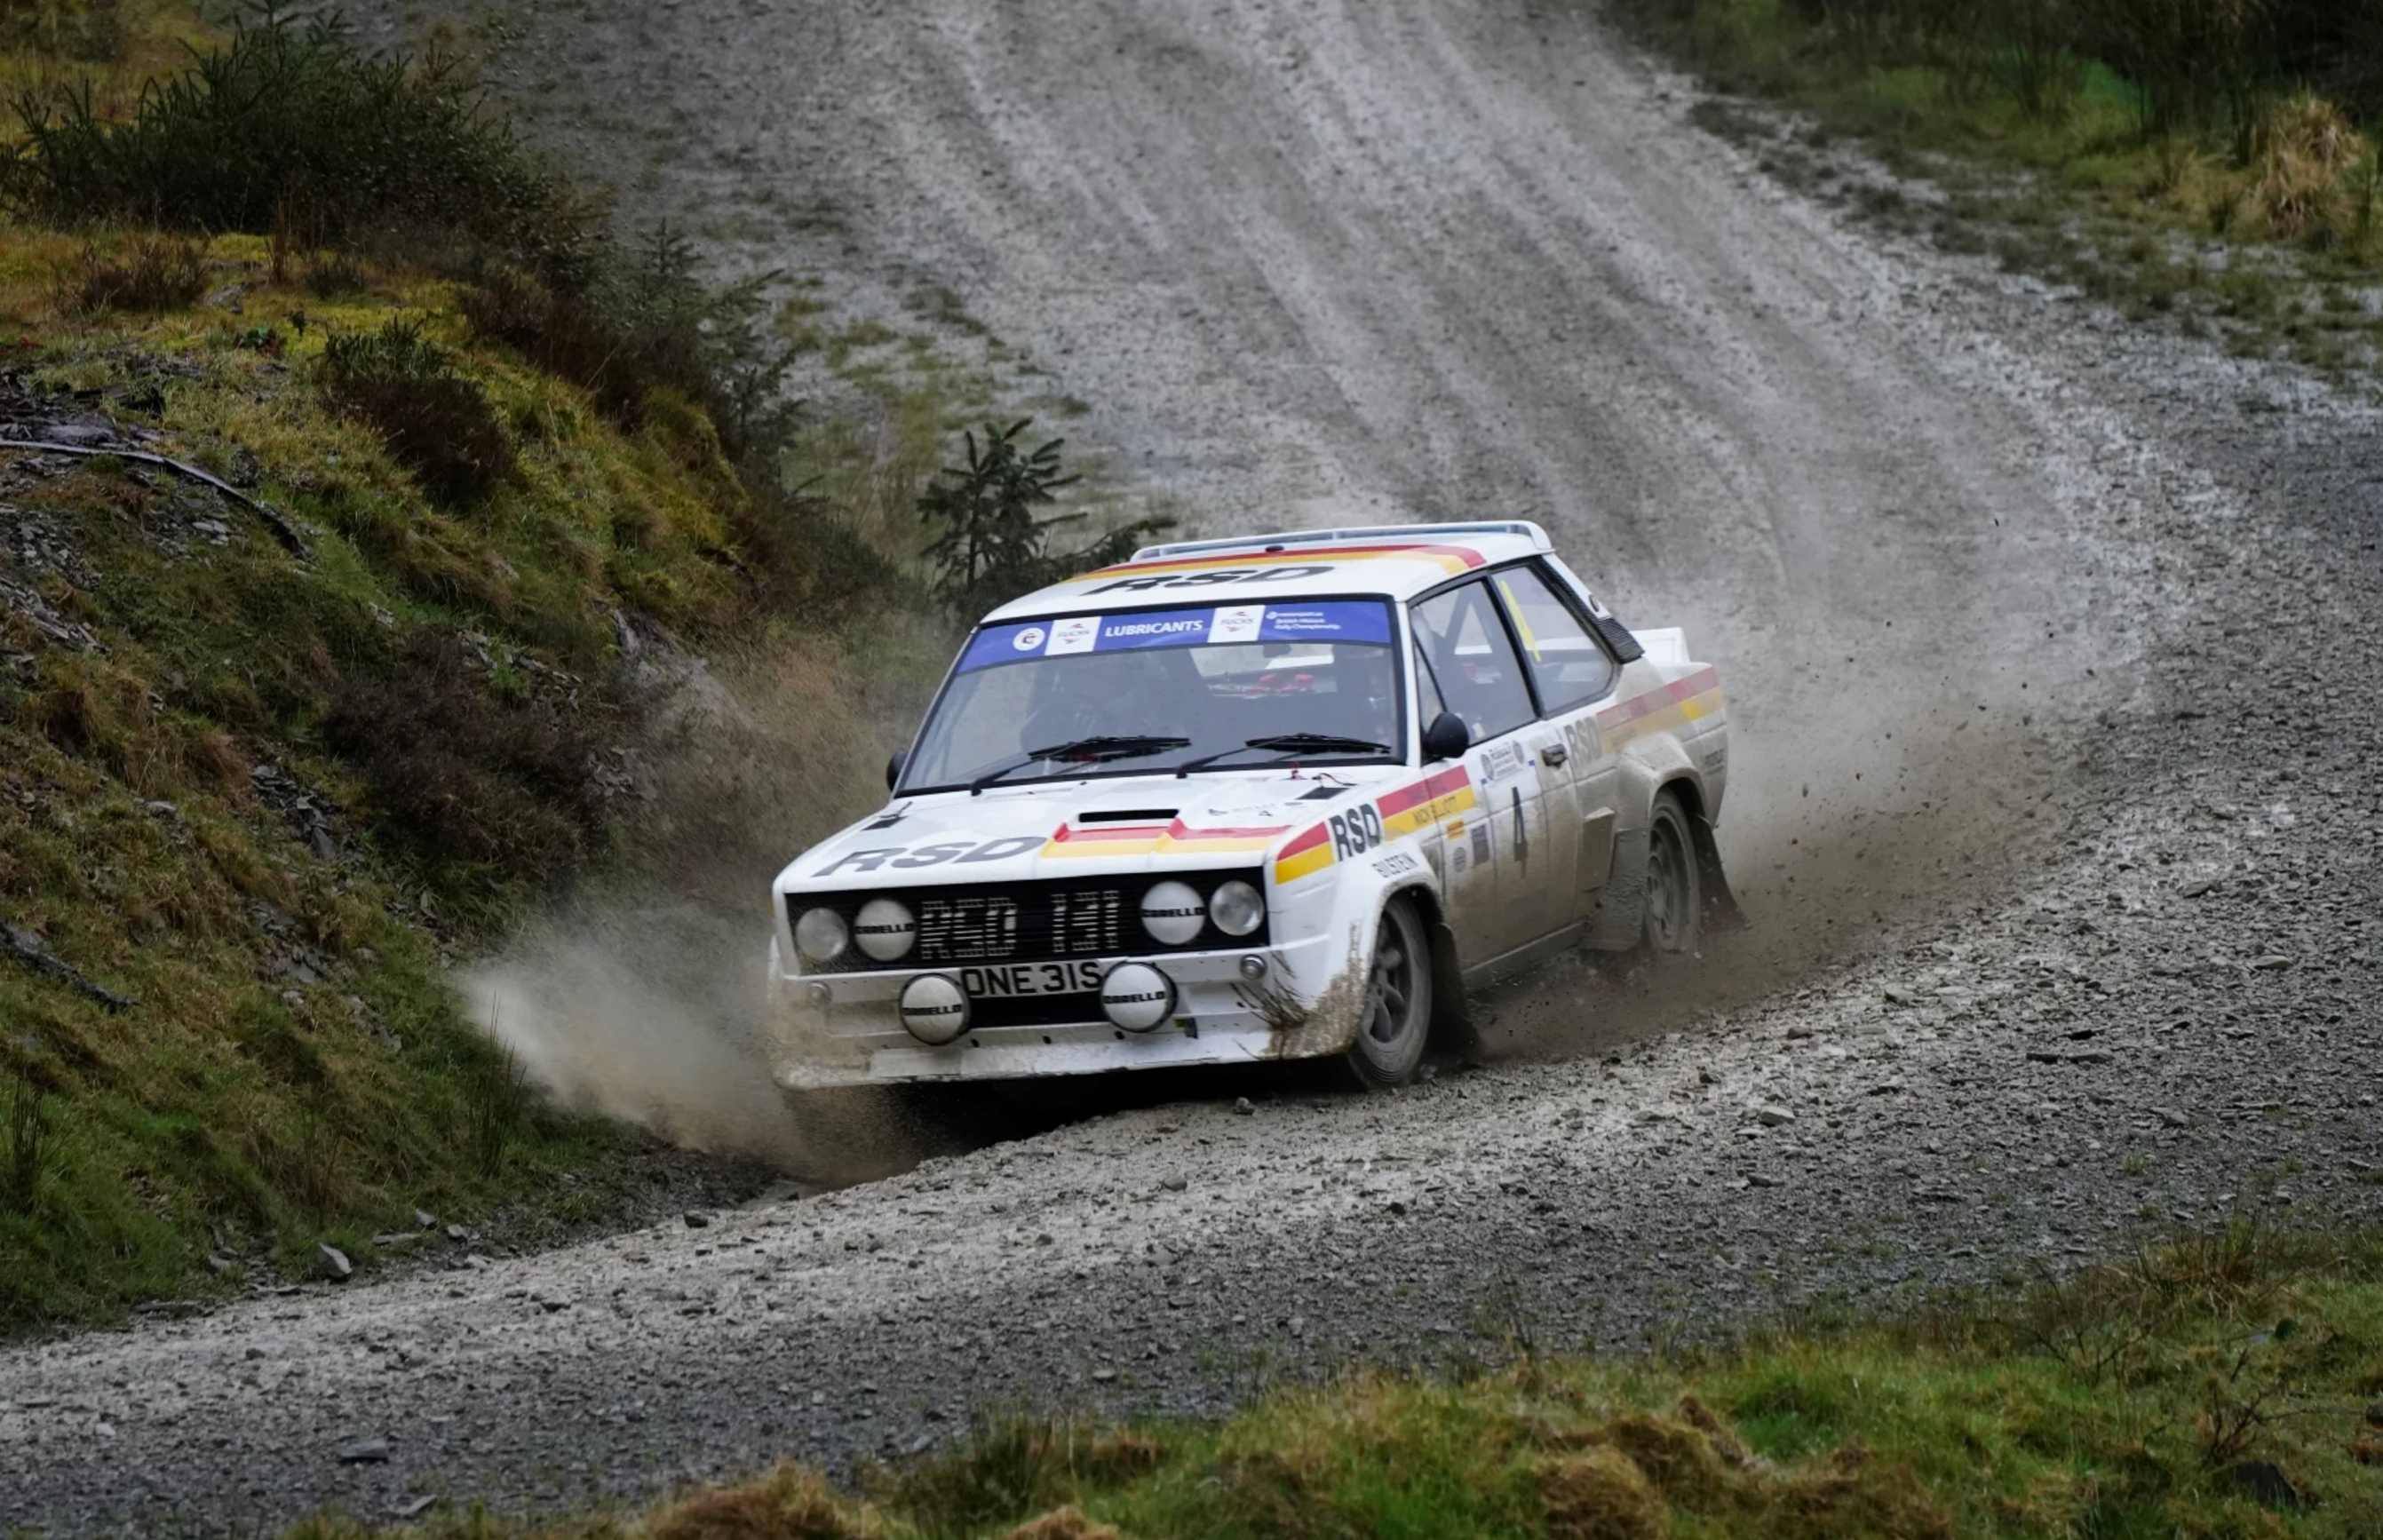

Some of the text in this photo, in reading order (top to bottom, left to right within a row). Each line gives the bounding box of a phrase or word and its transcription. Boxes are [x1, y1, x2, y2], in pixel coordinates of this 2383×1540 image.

[1077, 566, 1335, 597] RSD
[1104, 619, 1203, 638] LUBRICANTS
[1563, 717, 1602, 768] RSD
[1329, 803, 1381, 862] RSD
[810, 836, 1048, 877] RSD
